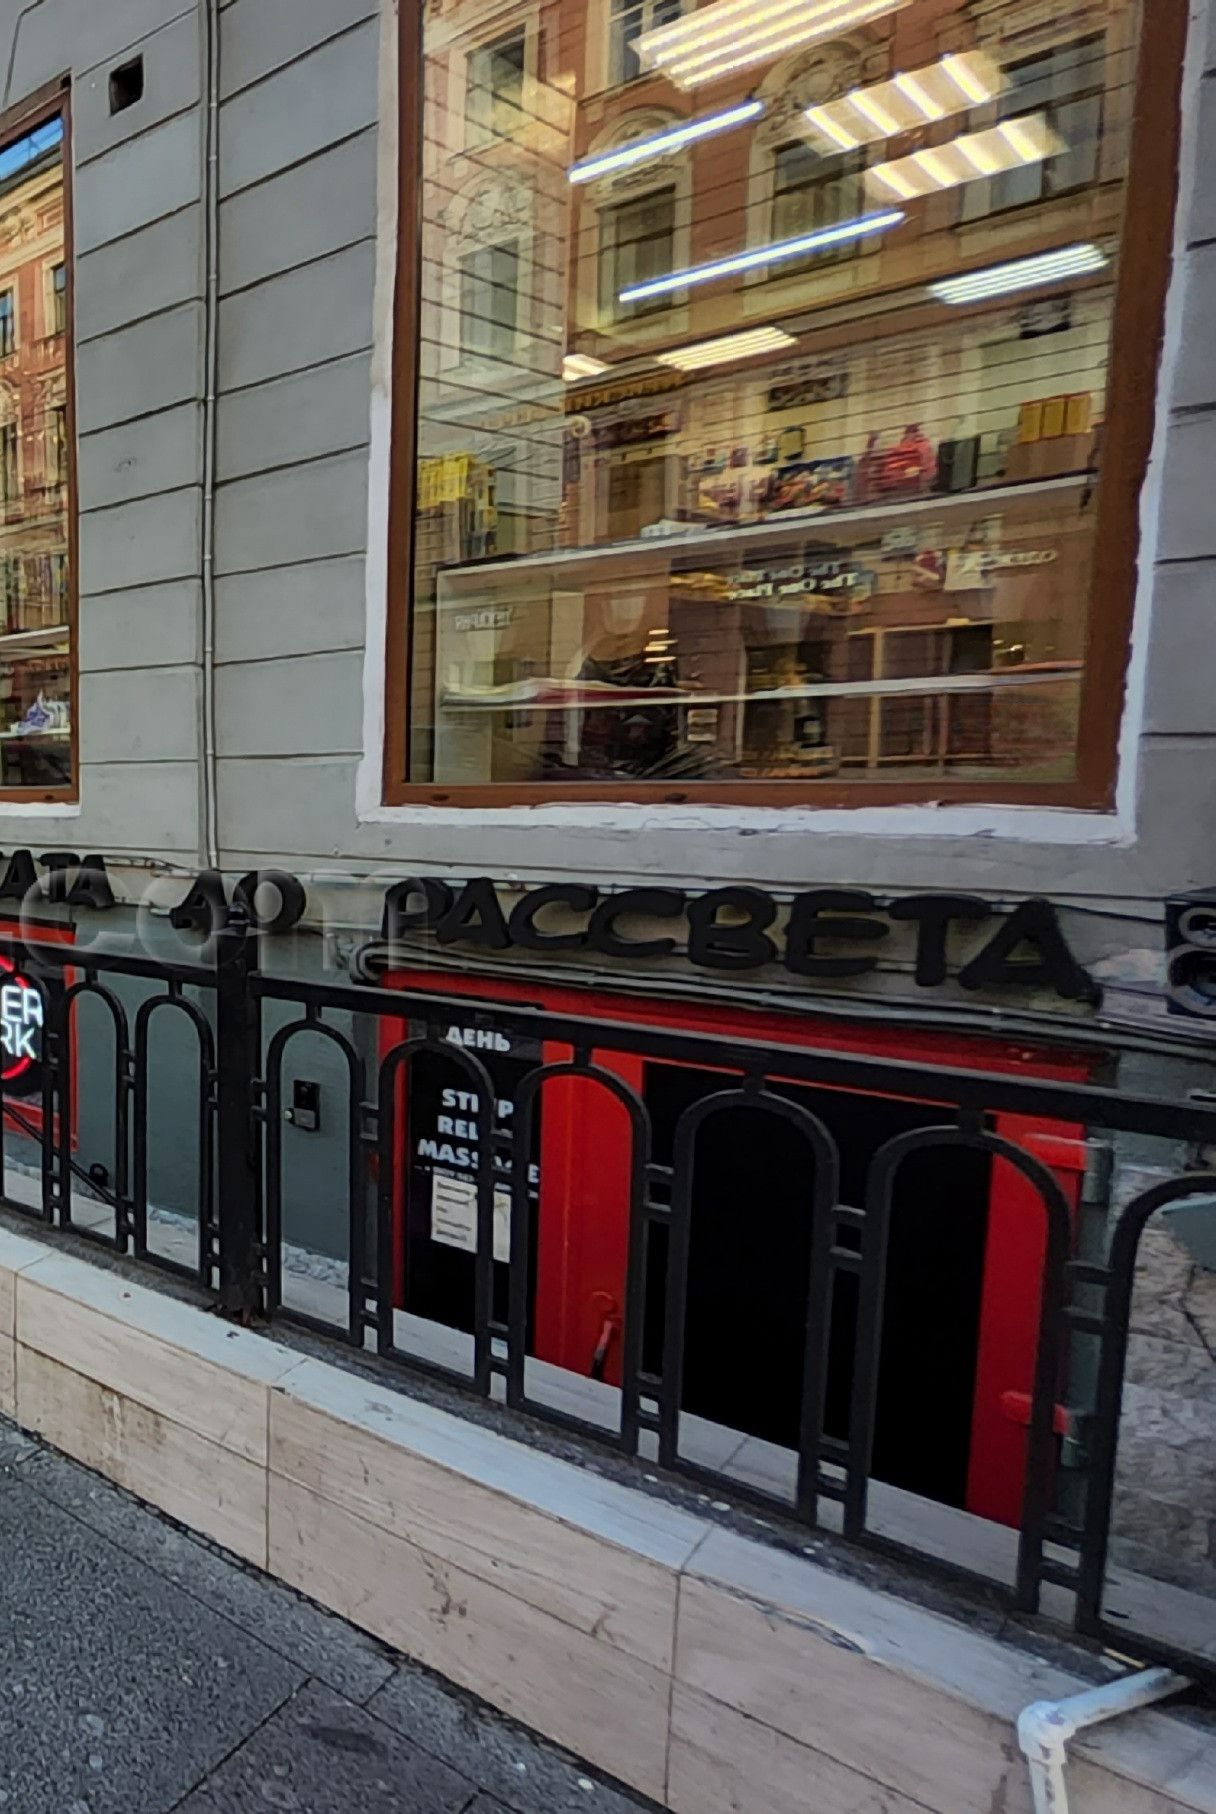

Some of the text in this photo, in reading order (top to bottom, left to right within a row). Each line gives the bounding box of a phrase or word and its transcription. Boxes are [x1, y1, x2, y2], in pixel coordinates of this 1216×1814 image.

[381, 877, 1104, 1009] РАССВЕТА
[442, 1089, 514, 1119] STP
[417, 1139, 540, 1184] MASE
